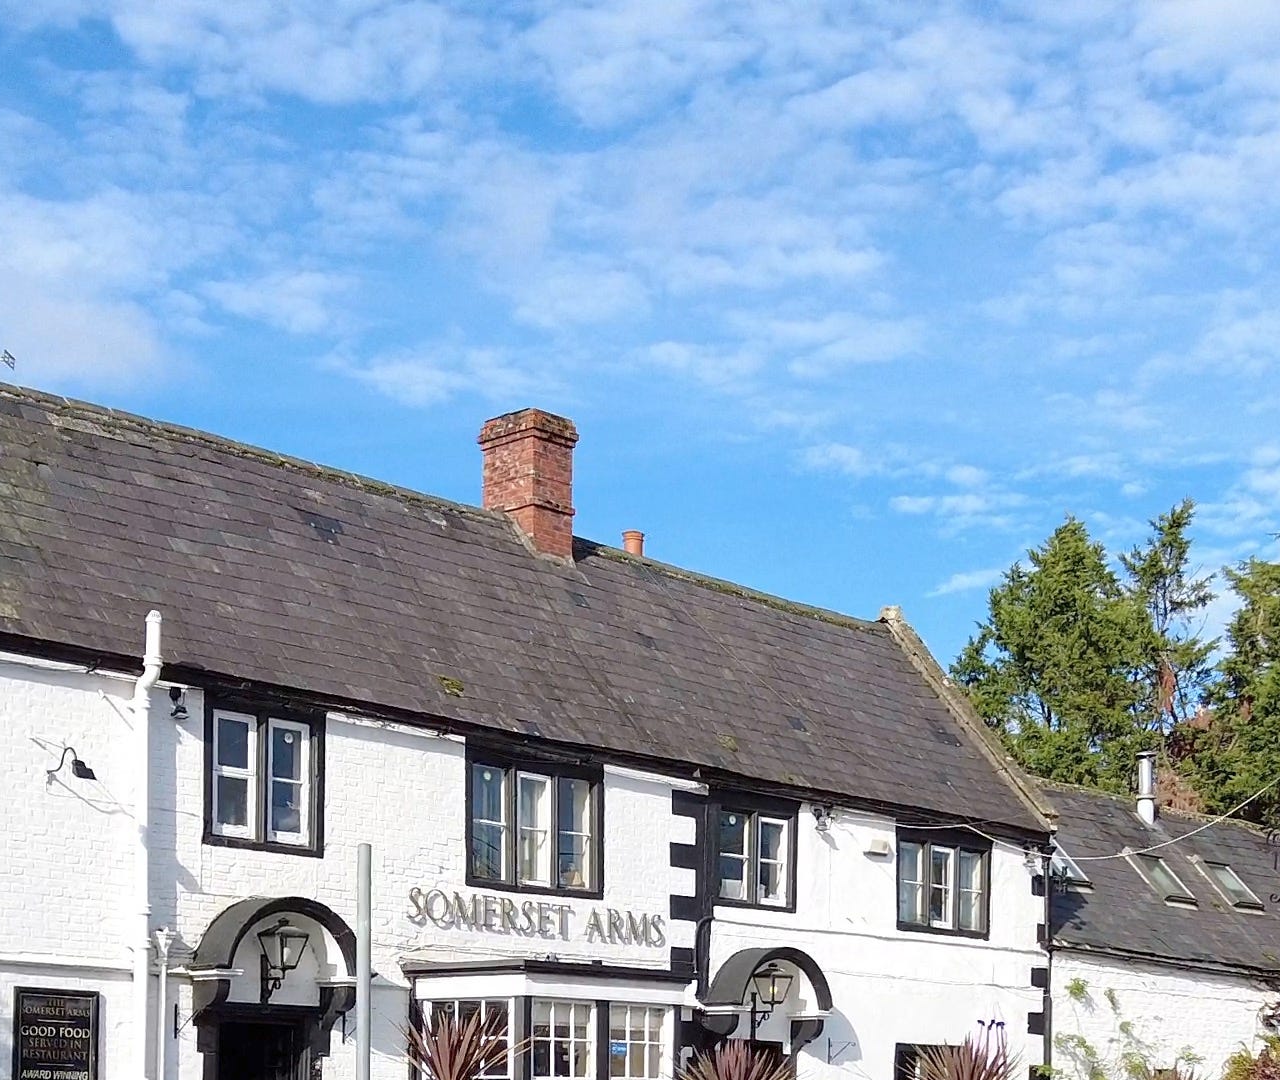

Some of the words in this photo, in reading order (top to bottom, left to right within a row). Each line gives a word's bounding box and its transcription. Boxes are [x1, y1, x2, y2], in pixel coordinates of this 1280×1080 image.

[407, 886, 572, 936] SOMERSET
[584, 907, 666, 945] ARMS
[23, 1005, 65, 1016] SOMERSET
[66, 1008, 90, 1018] ARMS
[21, 1025, 56, 1037] GOOD
[59, 1027, 90, 1039] FOOD
[28, 1039, 67, 1048] SERVED
[70, 1039, 82, 1049] IN
[22, 1049, 88, 1061] RESTAURANT
[21, 1069, 52, 1080] AWARD
[53, 1070, 89, 1080] WINNING
